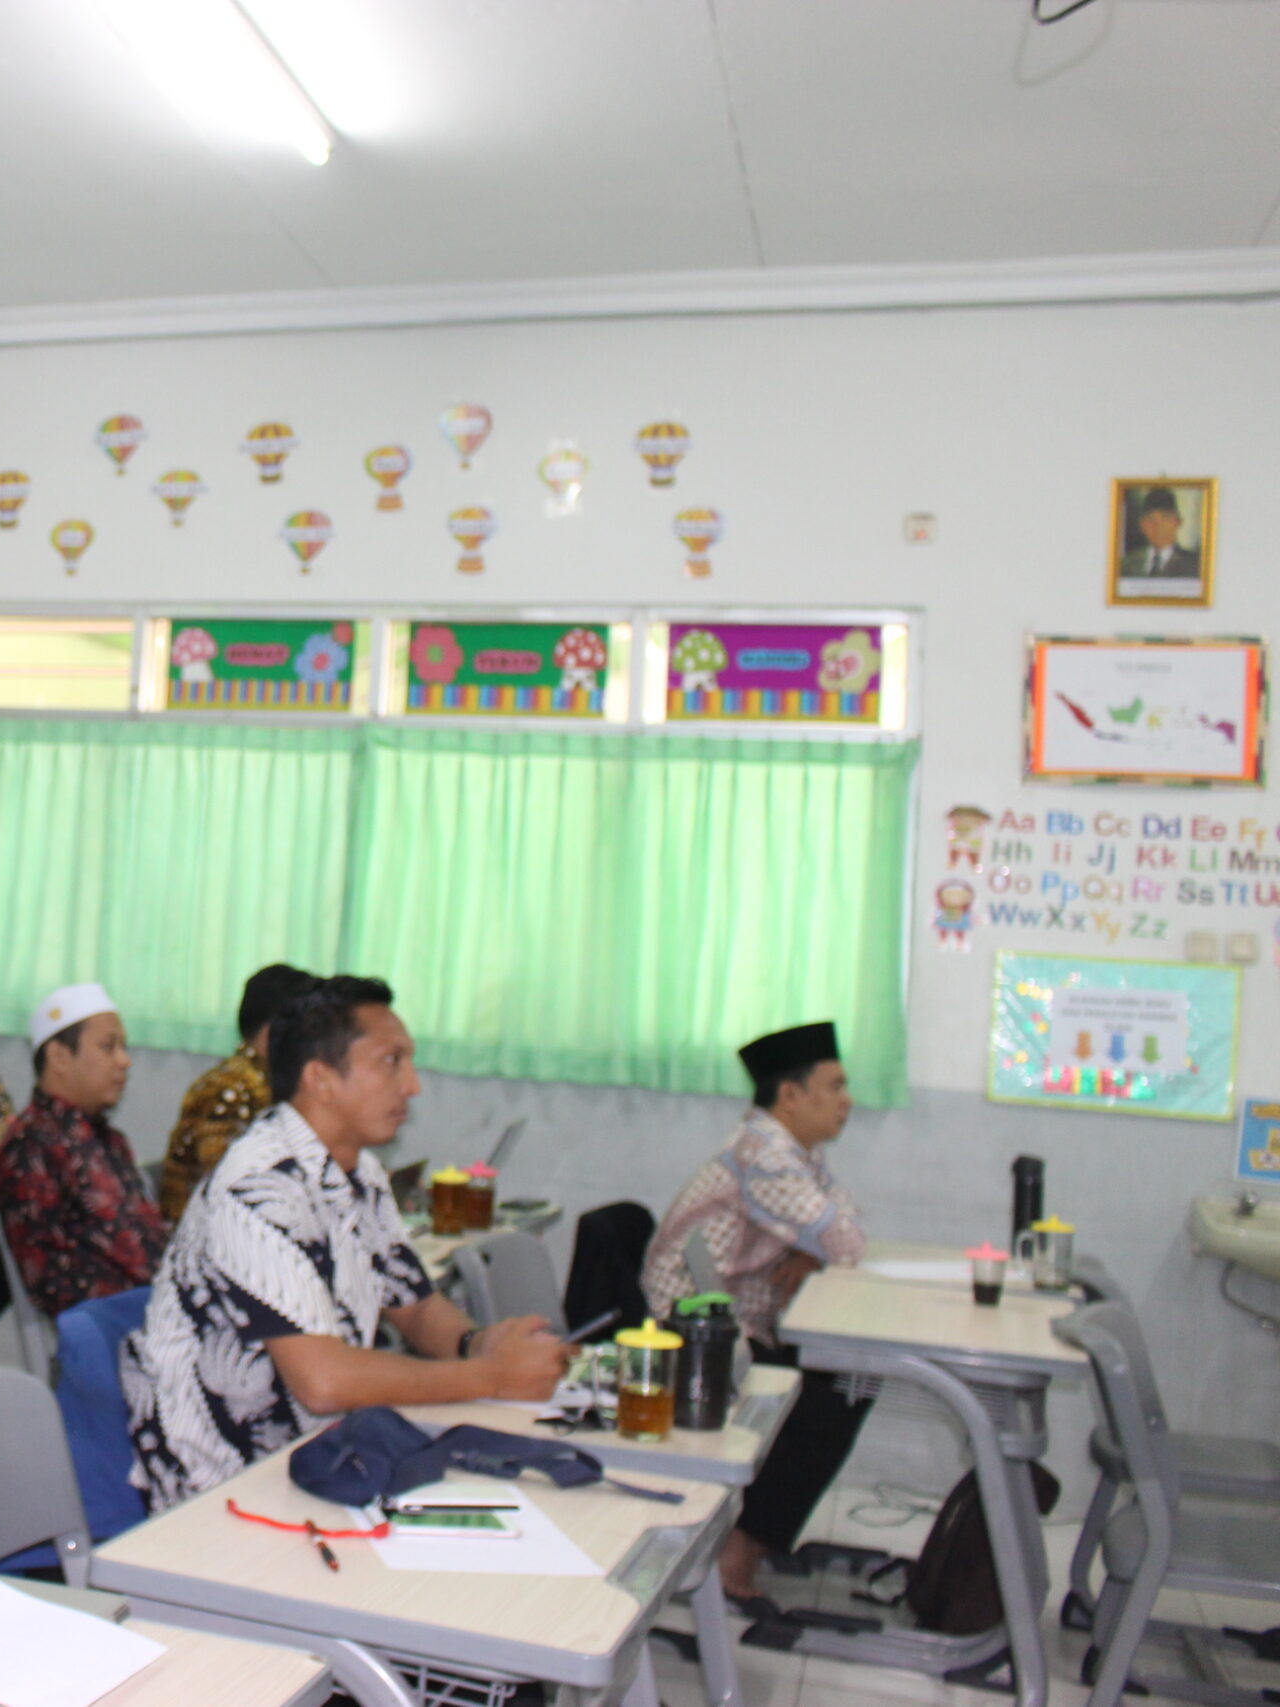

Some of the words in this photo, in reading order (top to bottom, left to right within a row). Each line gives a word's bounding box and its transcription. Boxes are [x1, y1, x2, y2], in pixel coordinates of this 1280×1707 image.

[999, 809, 1036, 834] Aa
[1046, 810, 1084, 836] Bb
[1093, 810, 1132, 837] Cc
[1142, 814, 1182, 839] Dd
[1190, 817, 1227, 842] Ee
[992, 839, 1033, 864] Hh
[1088, 842, 1117, 875] Jj
[1136, 845, 1176, 869] Kk
[1041, 871, 1080, 908] Pp
[1132, 877, 1164, 903] Rr
[1177, 879, 1215, 907] Ss
[1220, 880, 1249, 906] Tt
[989, 903, 1042, 926] Ww
[1091, 909, 1121, 944] Yy
[1129, 912, 1168, 938] Zz
